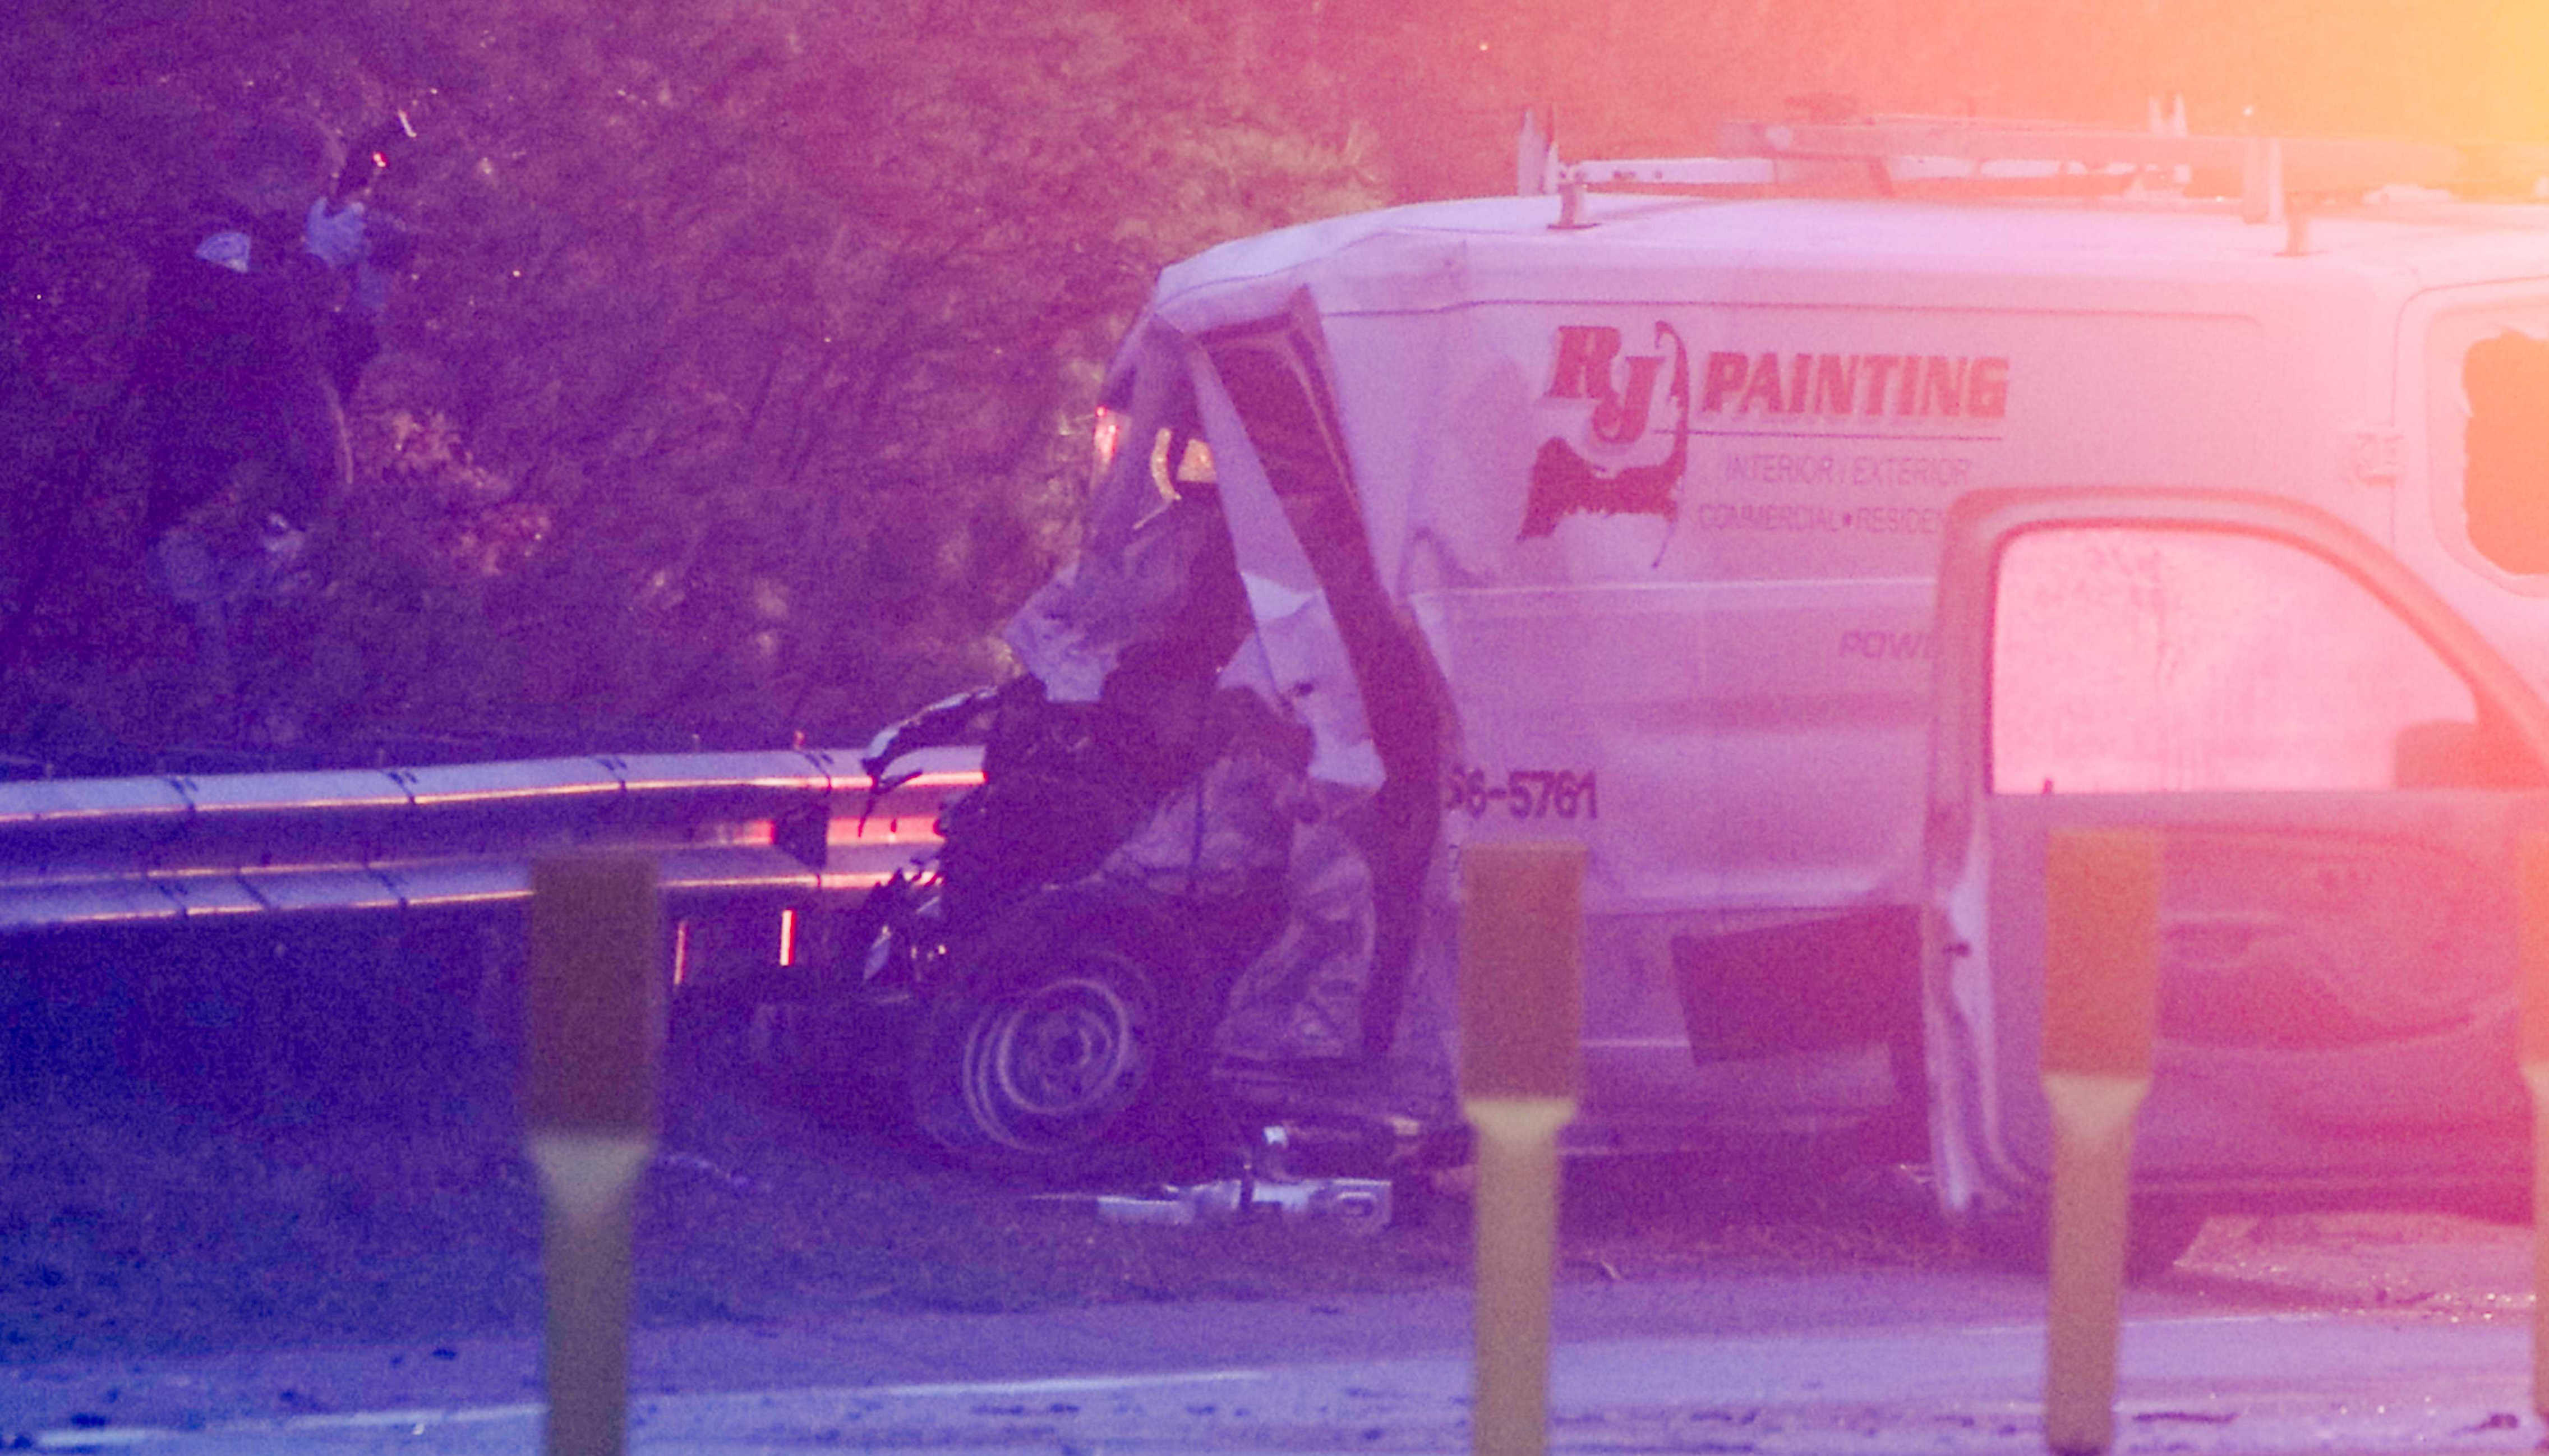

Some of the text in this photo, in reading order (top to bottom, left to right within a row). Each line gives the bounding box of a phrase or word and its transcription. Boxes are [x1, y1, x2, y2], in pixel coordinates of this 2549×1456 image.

[1702, 351, 2010, 417] PAINTING
[1726, 453, 1834, 484] INTERIOR
[1852, 456, 1972, 487] EXTERIOR
